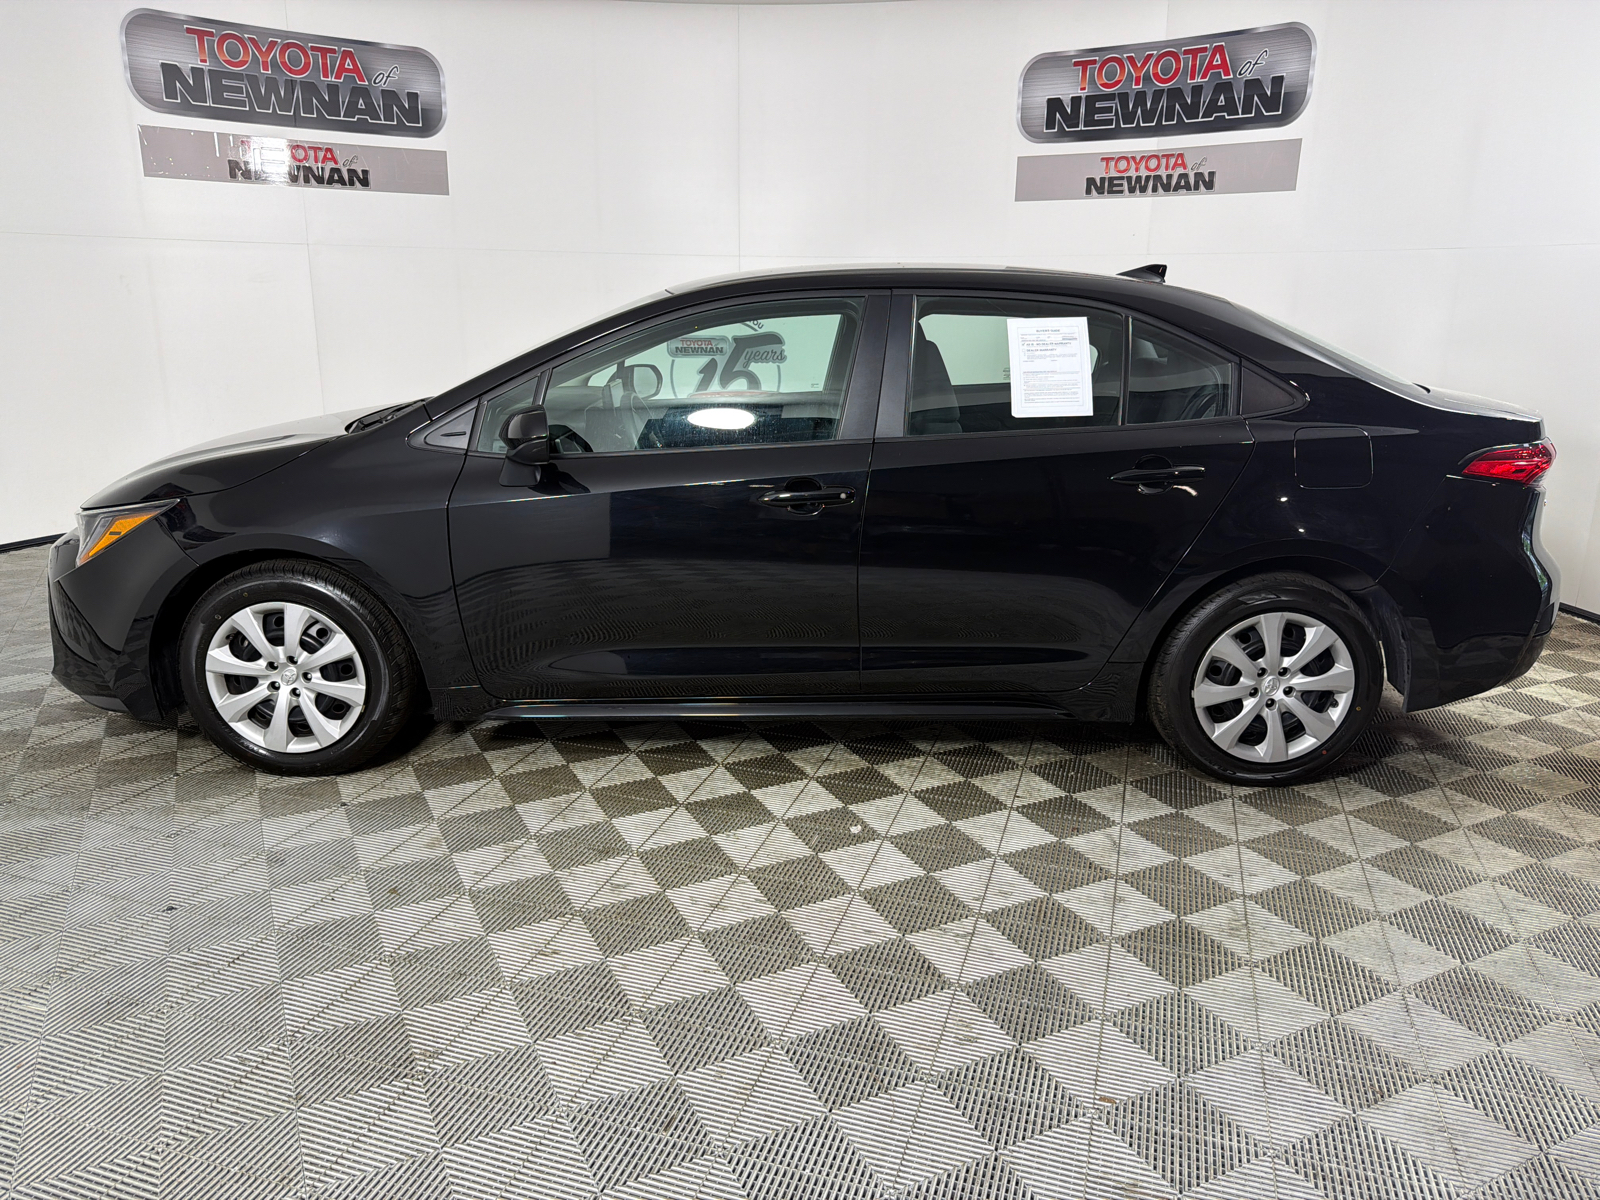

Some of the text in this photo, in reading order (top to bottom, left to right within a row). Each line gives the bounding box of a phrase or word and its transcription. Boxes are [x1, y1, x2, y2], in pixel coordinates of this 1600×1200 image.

[184, 25, 399, 87] TOYOTA of
[1072, 42, 1268, 92] TOYOTA of
[159, 61, 422, 126] NEWNAN
[1043, 73, 1286, 132] NEWNAN
[240, 139, 359, 168] TOTA of
[1100, 152, 1207, 175] TOYOTA of
[227, 158, 371, 188] NNAN
[1085, 171, 1216, 196] NEWNAN
[675, 346, 724, 354] NEWNAN
[680, 339, 713, 347] TOYOTA
[743, 349, 785, 368] years
